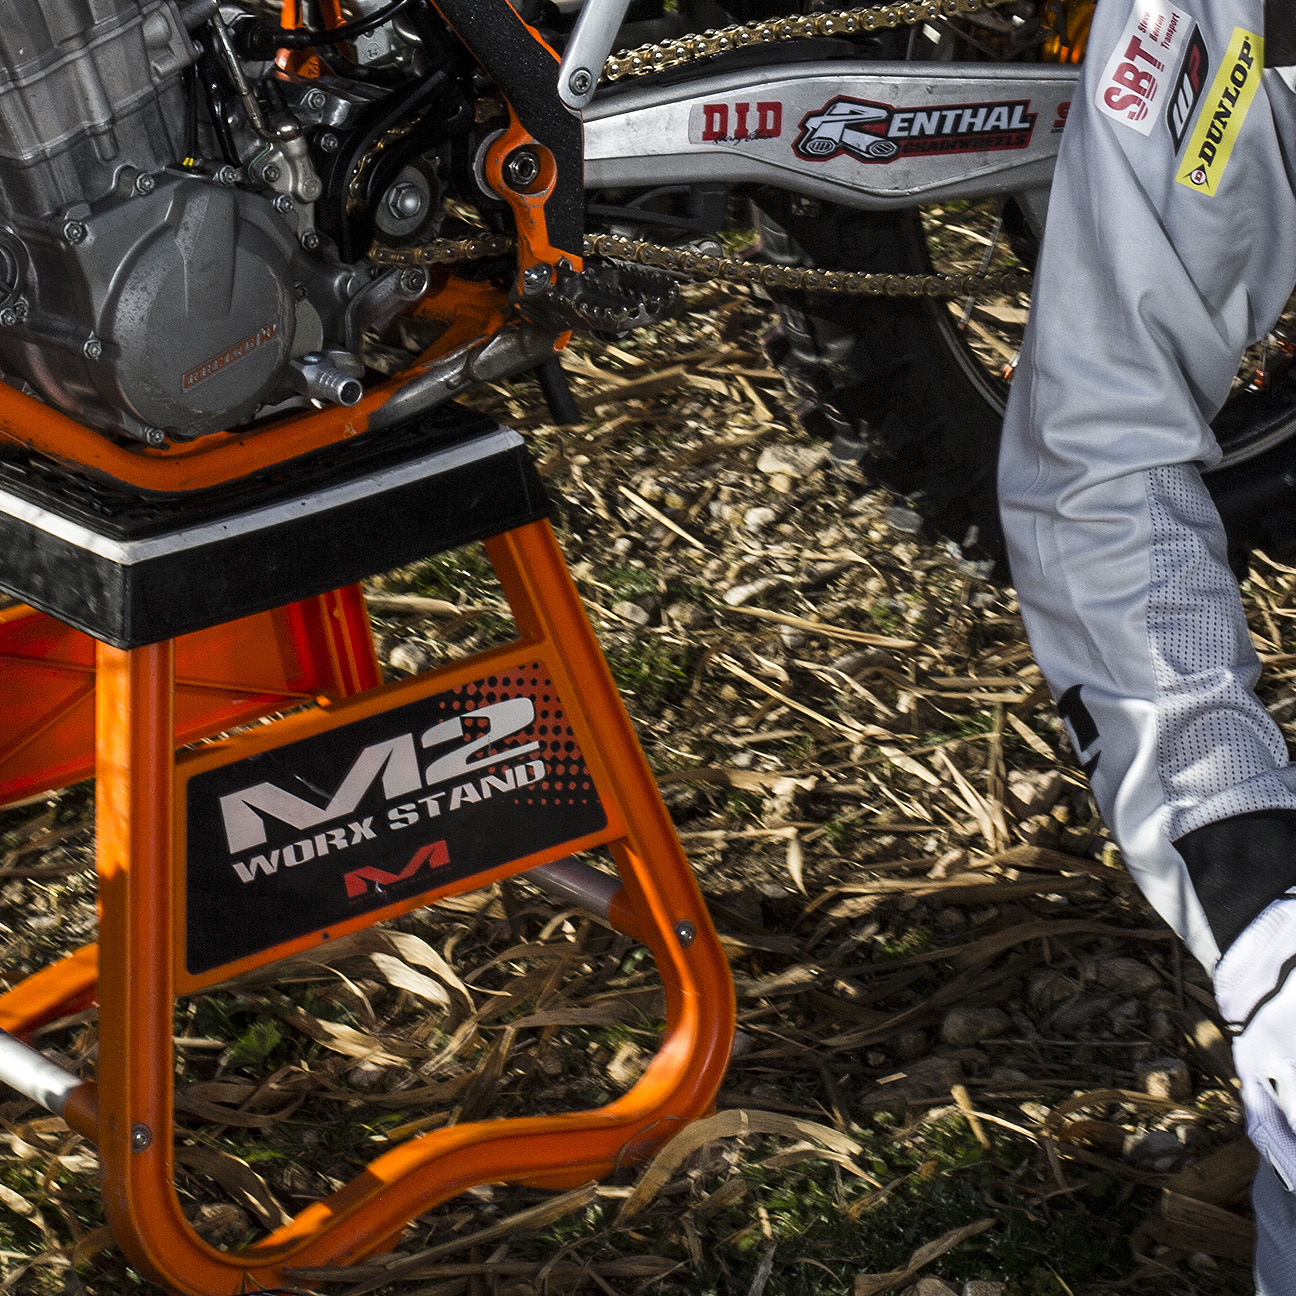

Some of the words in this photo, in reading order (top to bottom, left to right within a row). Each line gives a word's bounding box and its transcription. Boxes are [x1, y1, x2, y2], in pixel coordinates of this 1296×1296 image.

[1103, 35, 1165, 122] SBT
[1160, 12, 1180, 50] Transport
[702, 101, 783, 142] DID
[1198, 39, 1255, 168] DUNLOP
[219, 696, 540, 854] M2
[231, 816, 376, 884] WORX
[388, 759, 547, 832] STAND
